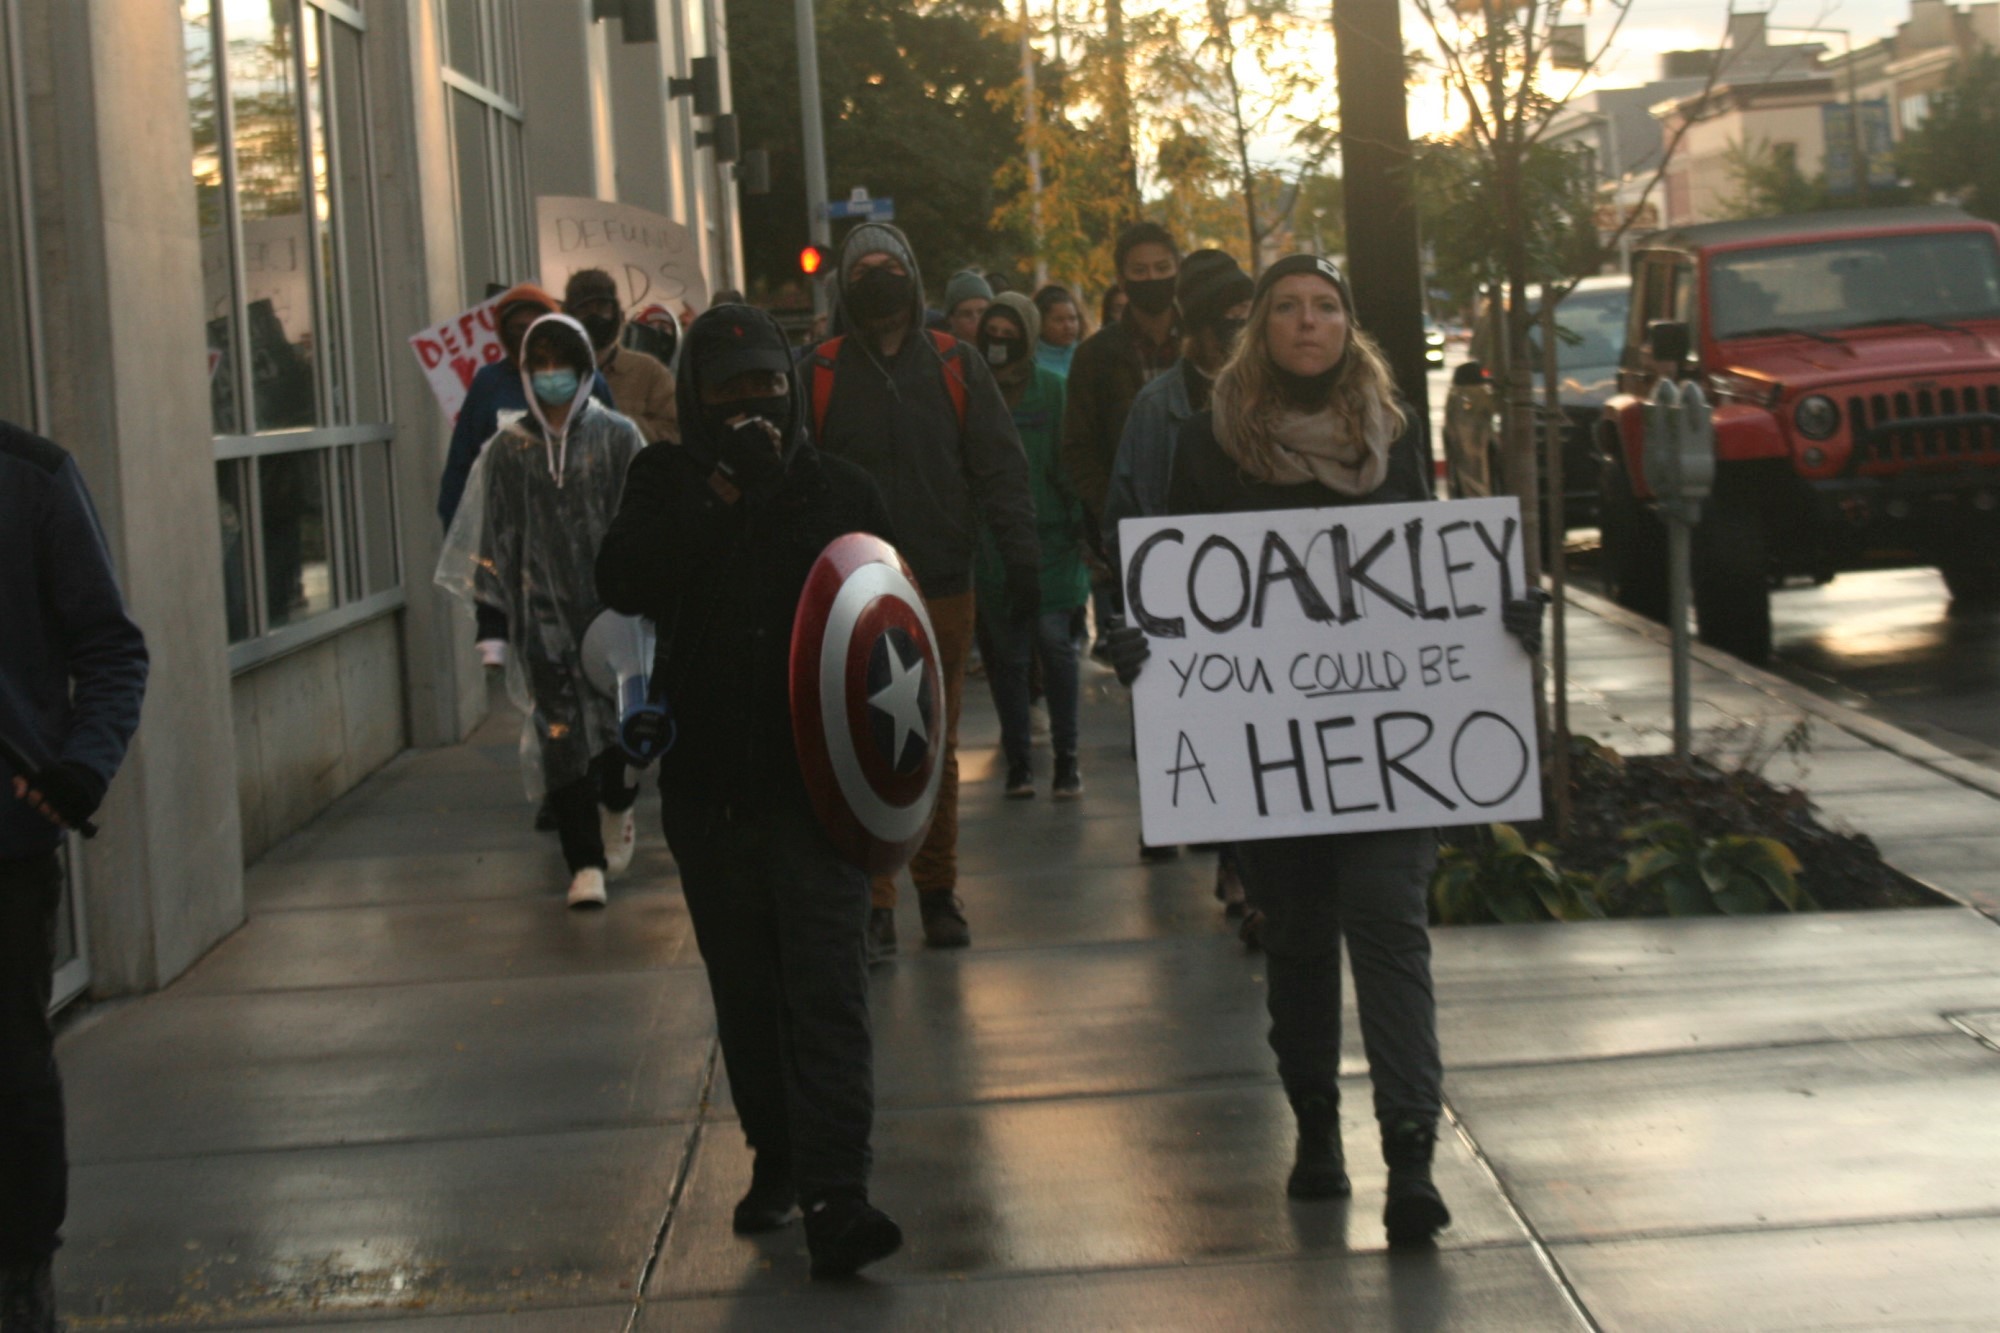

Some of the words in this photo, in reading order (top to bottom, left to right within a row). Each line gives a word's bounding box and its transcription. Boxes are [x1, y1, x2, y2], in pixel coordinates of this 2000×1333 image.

[415, 304, 498, 370] DEFU
[1126, 517, 1517, 639] COAKLEY
[1169, 652, 1274, 699] YOU
[1289, 650, 1408, 697] COULD
[1419, 644, 1472, 687] BE
[1165, 730, 1218, 808] A
[1245, 710, 1530, 817] HERO
